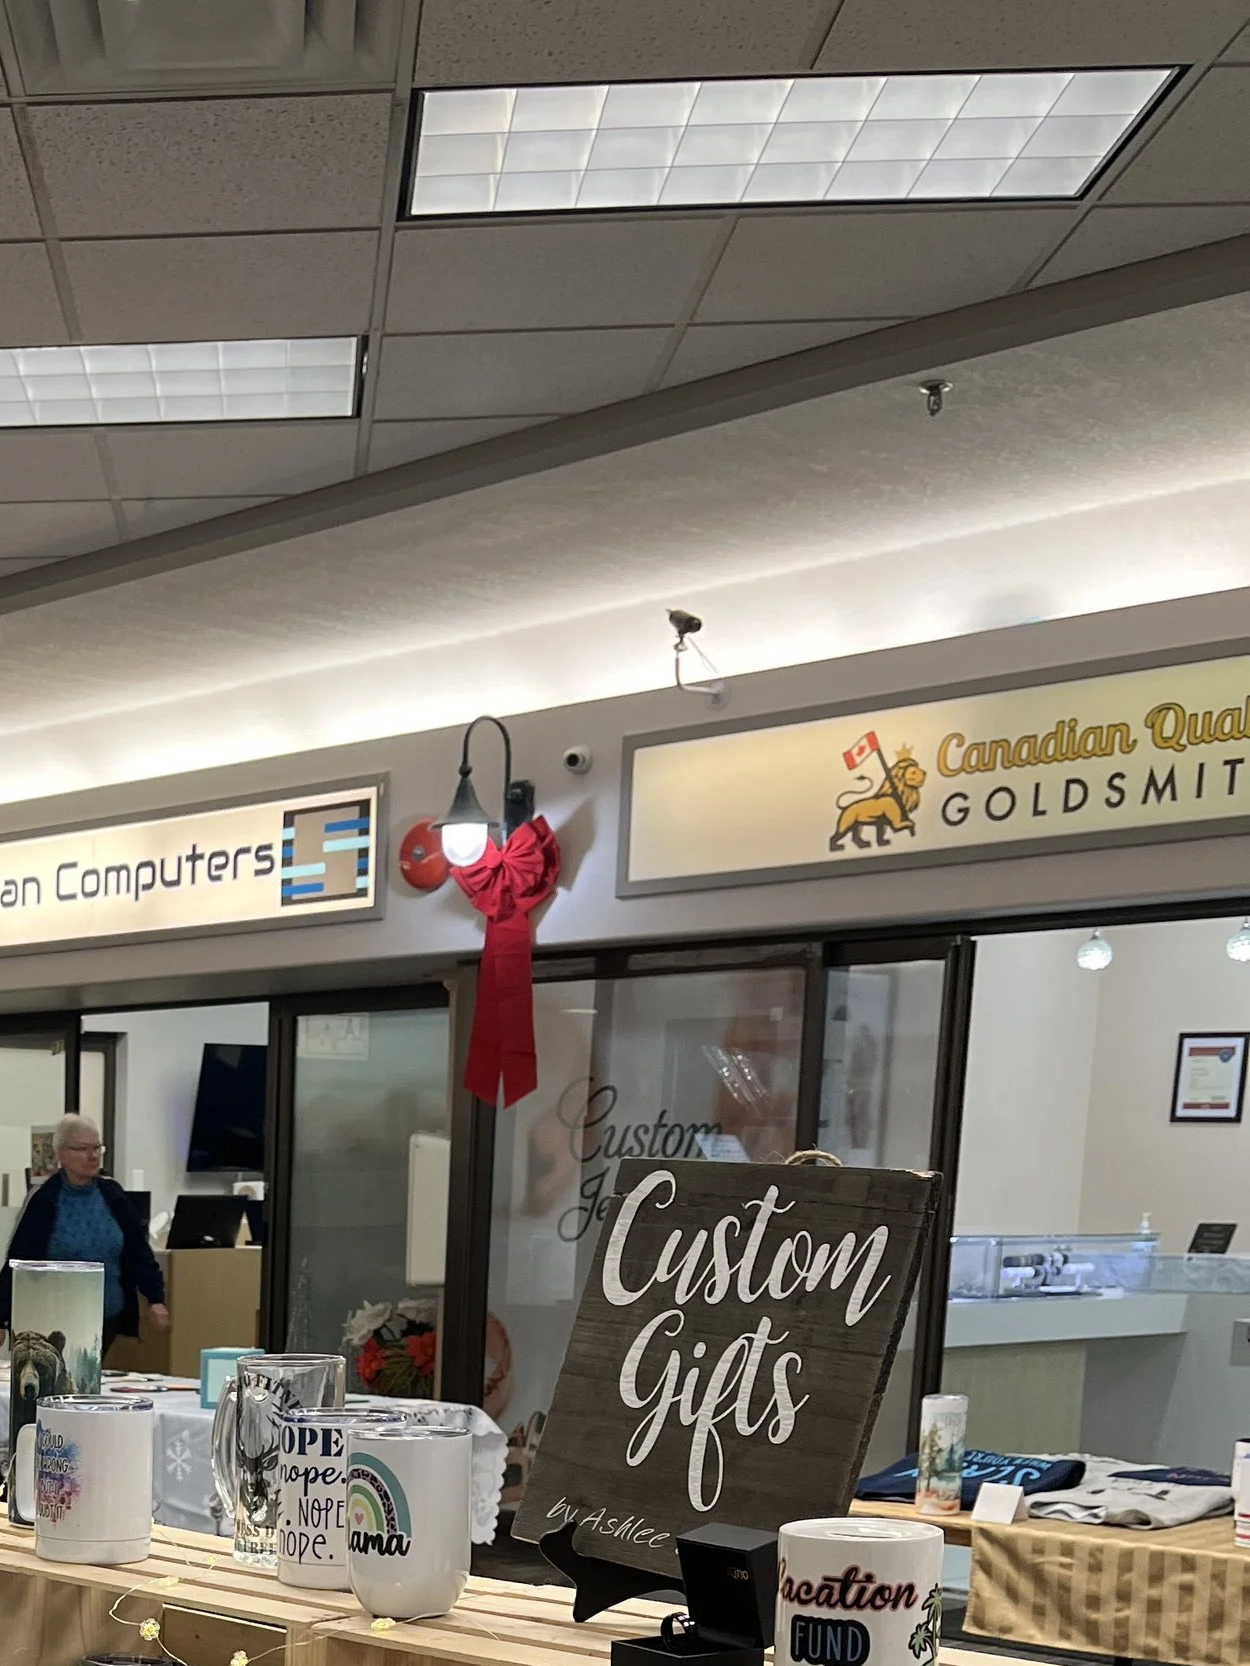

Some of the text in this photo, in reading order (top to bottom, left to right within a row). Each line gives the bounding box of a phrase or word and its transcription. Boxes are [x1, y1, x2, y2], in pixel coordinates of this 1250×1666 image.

[936, 717, 1138, 778] Canadian
[940, 757, 1246, 827] GOLDSMIT
[55, 843, 276, 902] Computers
[556, 1077, 723, 1159] Custom
[602, 1168, 893, 1329] Custom
[618, 1307, 811, 1513] Gifts
[281, 1427, 346, 1457] OPE
[349, 1530, 411, 1557] ama
[545, 1497, 672, 1550] by Ashlee
[793, 1620, 864, 1663] FUND
